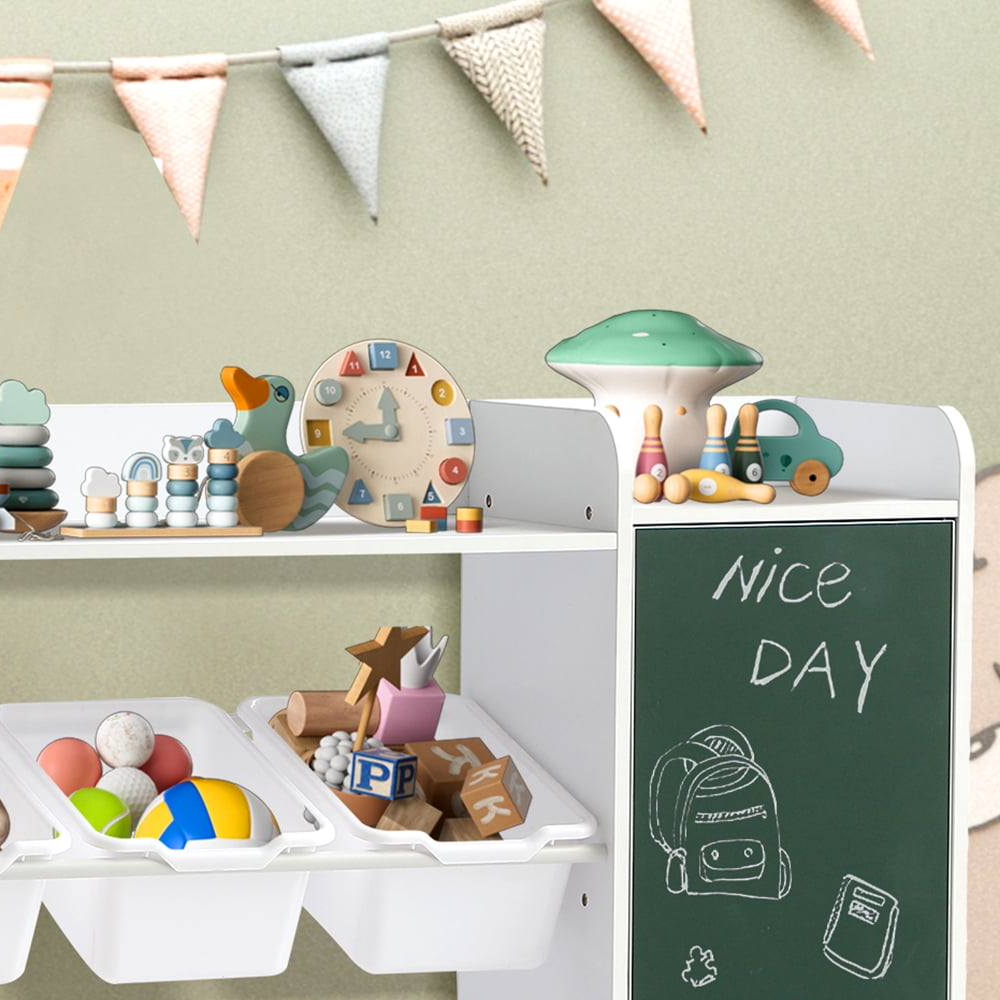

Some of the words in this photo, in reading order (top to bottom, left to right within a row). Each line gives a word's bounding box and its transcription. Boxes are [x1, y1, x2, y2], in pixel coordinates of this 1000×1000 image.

[380, 350, 392, 359] 12
[349, 361, 360, 370] 11
[412, 365, 418, 373] 1
[325, 386, 337, 395] 10
[439, 388, 446, 398] 2
[314, 429, 321, 438] 9
[459, 427, 466, 436] 3
[452, 466, 459, 474] 4
[657, 469, 663, 478] 2
[752, 468, 758, 477] 6
[359, 489, 366, 498] 7
[428, 491, 434, 501] 5
[397, 503, 404, 511] 6
[712, 547, 852, 608] Nice
[750, 639, 887, 713] DAY
[356, 759, 390, 790] P
[397, 764, 414, 794] P
[473, 795, 512, 825] K
